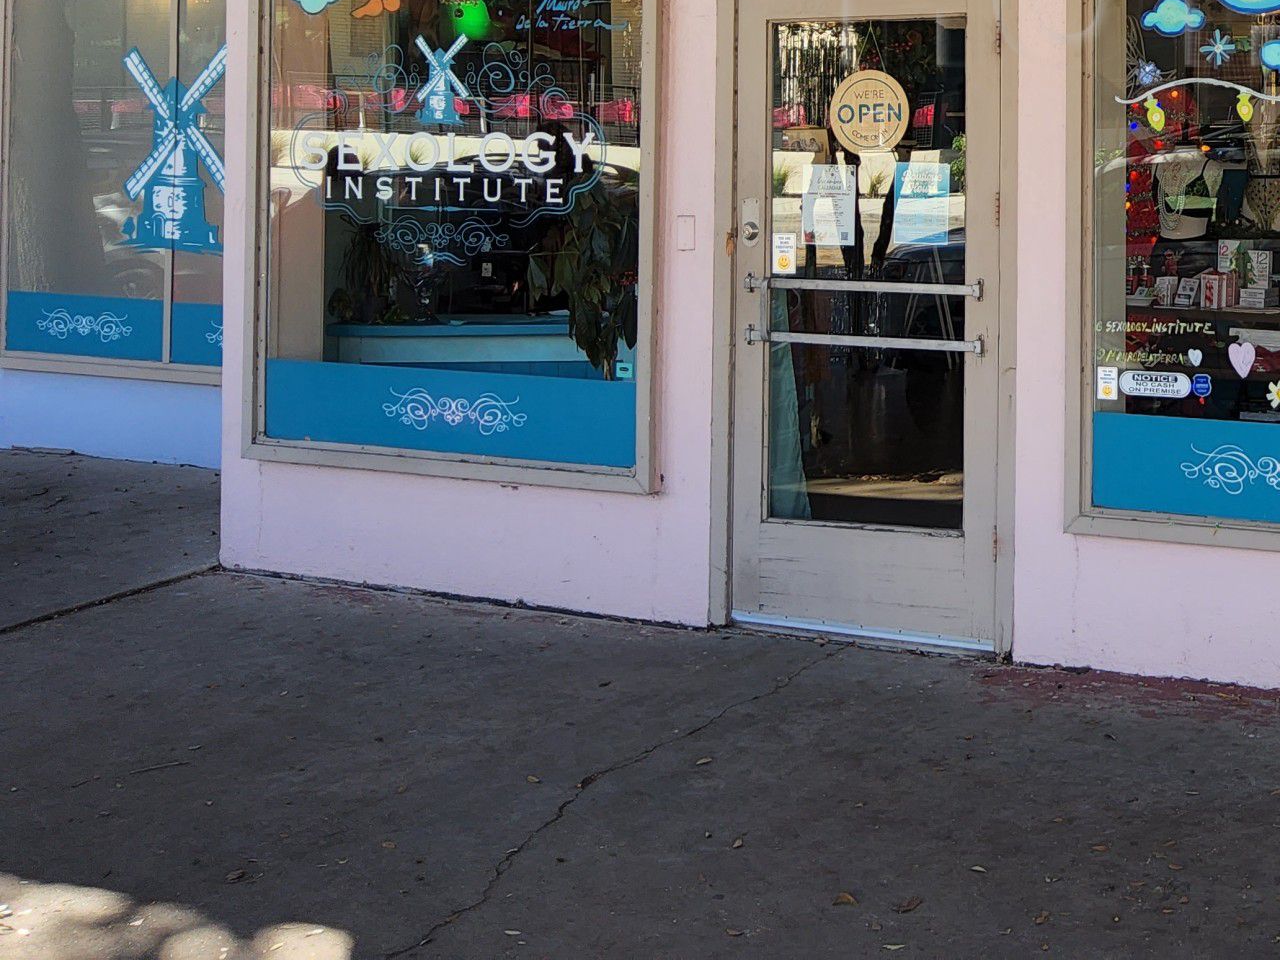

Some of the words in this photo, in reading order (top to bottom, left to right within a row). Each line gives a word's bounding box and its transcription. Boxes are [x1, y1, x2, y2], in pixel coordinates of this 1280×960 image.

[854, 89, 885, 100] WE'RE
[837, 102, 903, 125] OPEN
[300, 130, 597, 175] SEXOLOGY
[325, 176, 565, 204] INSTITUTE
[1256, 251, 1268, 265] 12
[1133, 374, 1178, 383] NOTICE
[1143, 386, 1182, 395] PREMISE
